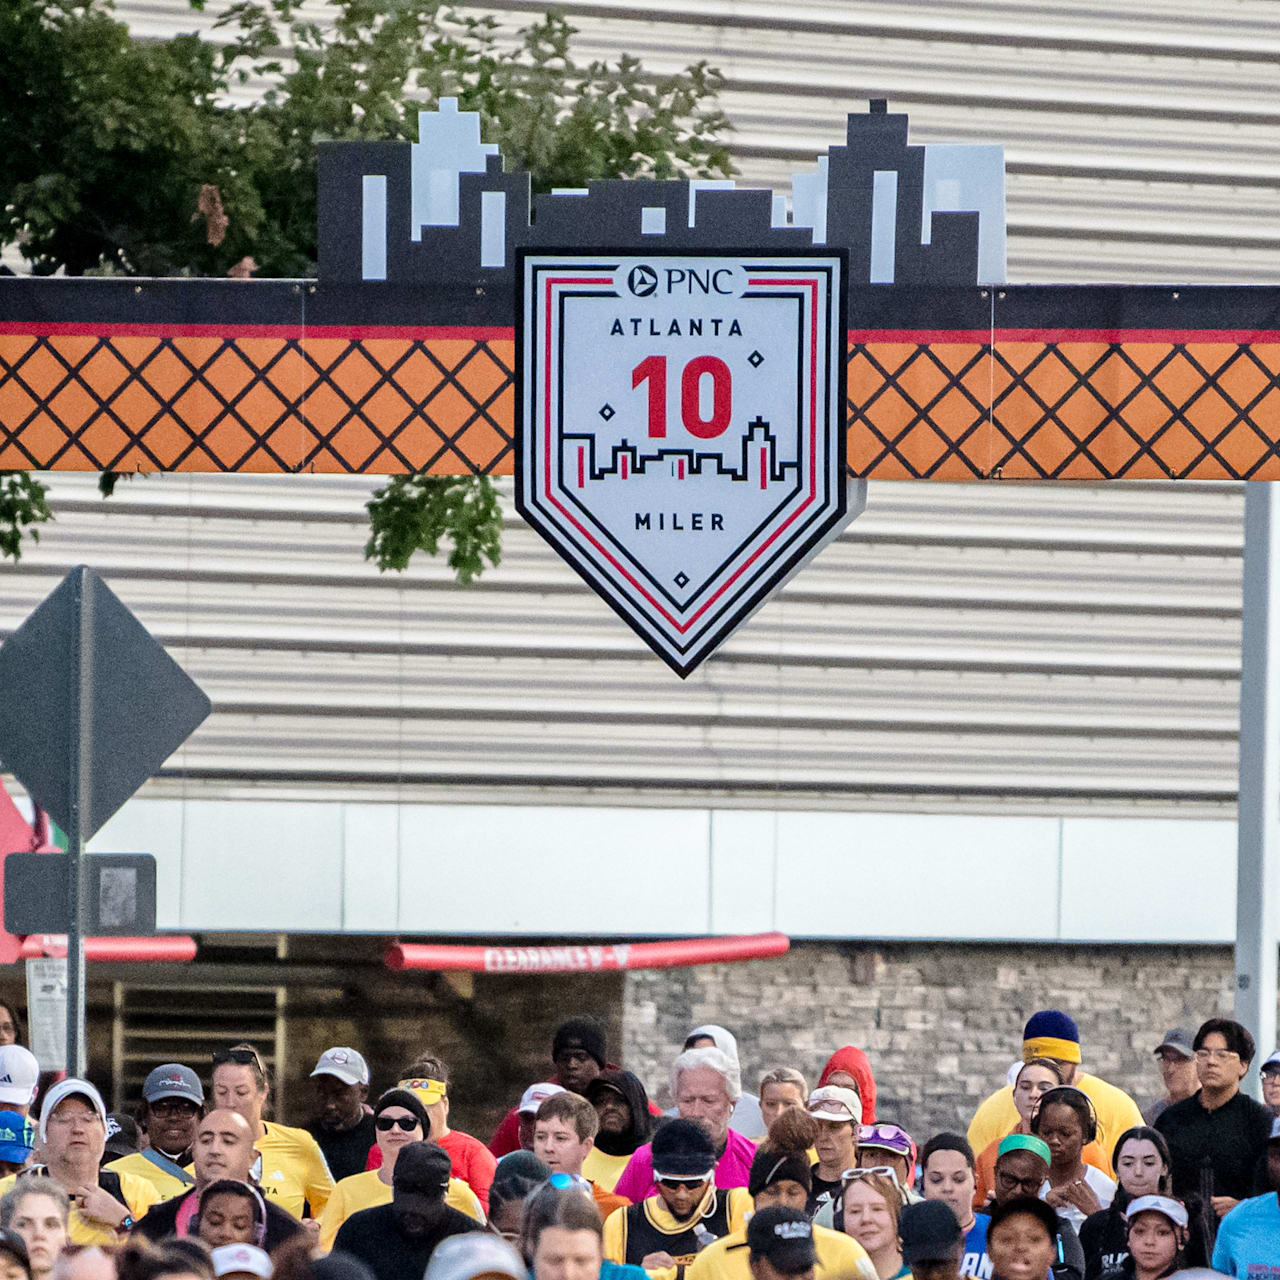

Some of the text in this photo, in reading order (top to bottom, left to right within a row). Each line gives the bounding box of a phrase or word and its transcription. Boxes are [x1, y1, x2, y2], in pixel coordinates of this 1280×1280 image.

[665, 268, 734, 296] PNC
[610, 318, 743, 337] ATLANTA
[631, 354, 733, 440] 10
[635, 512, 724, 531] MILER
